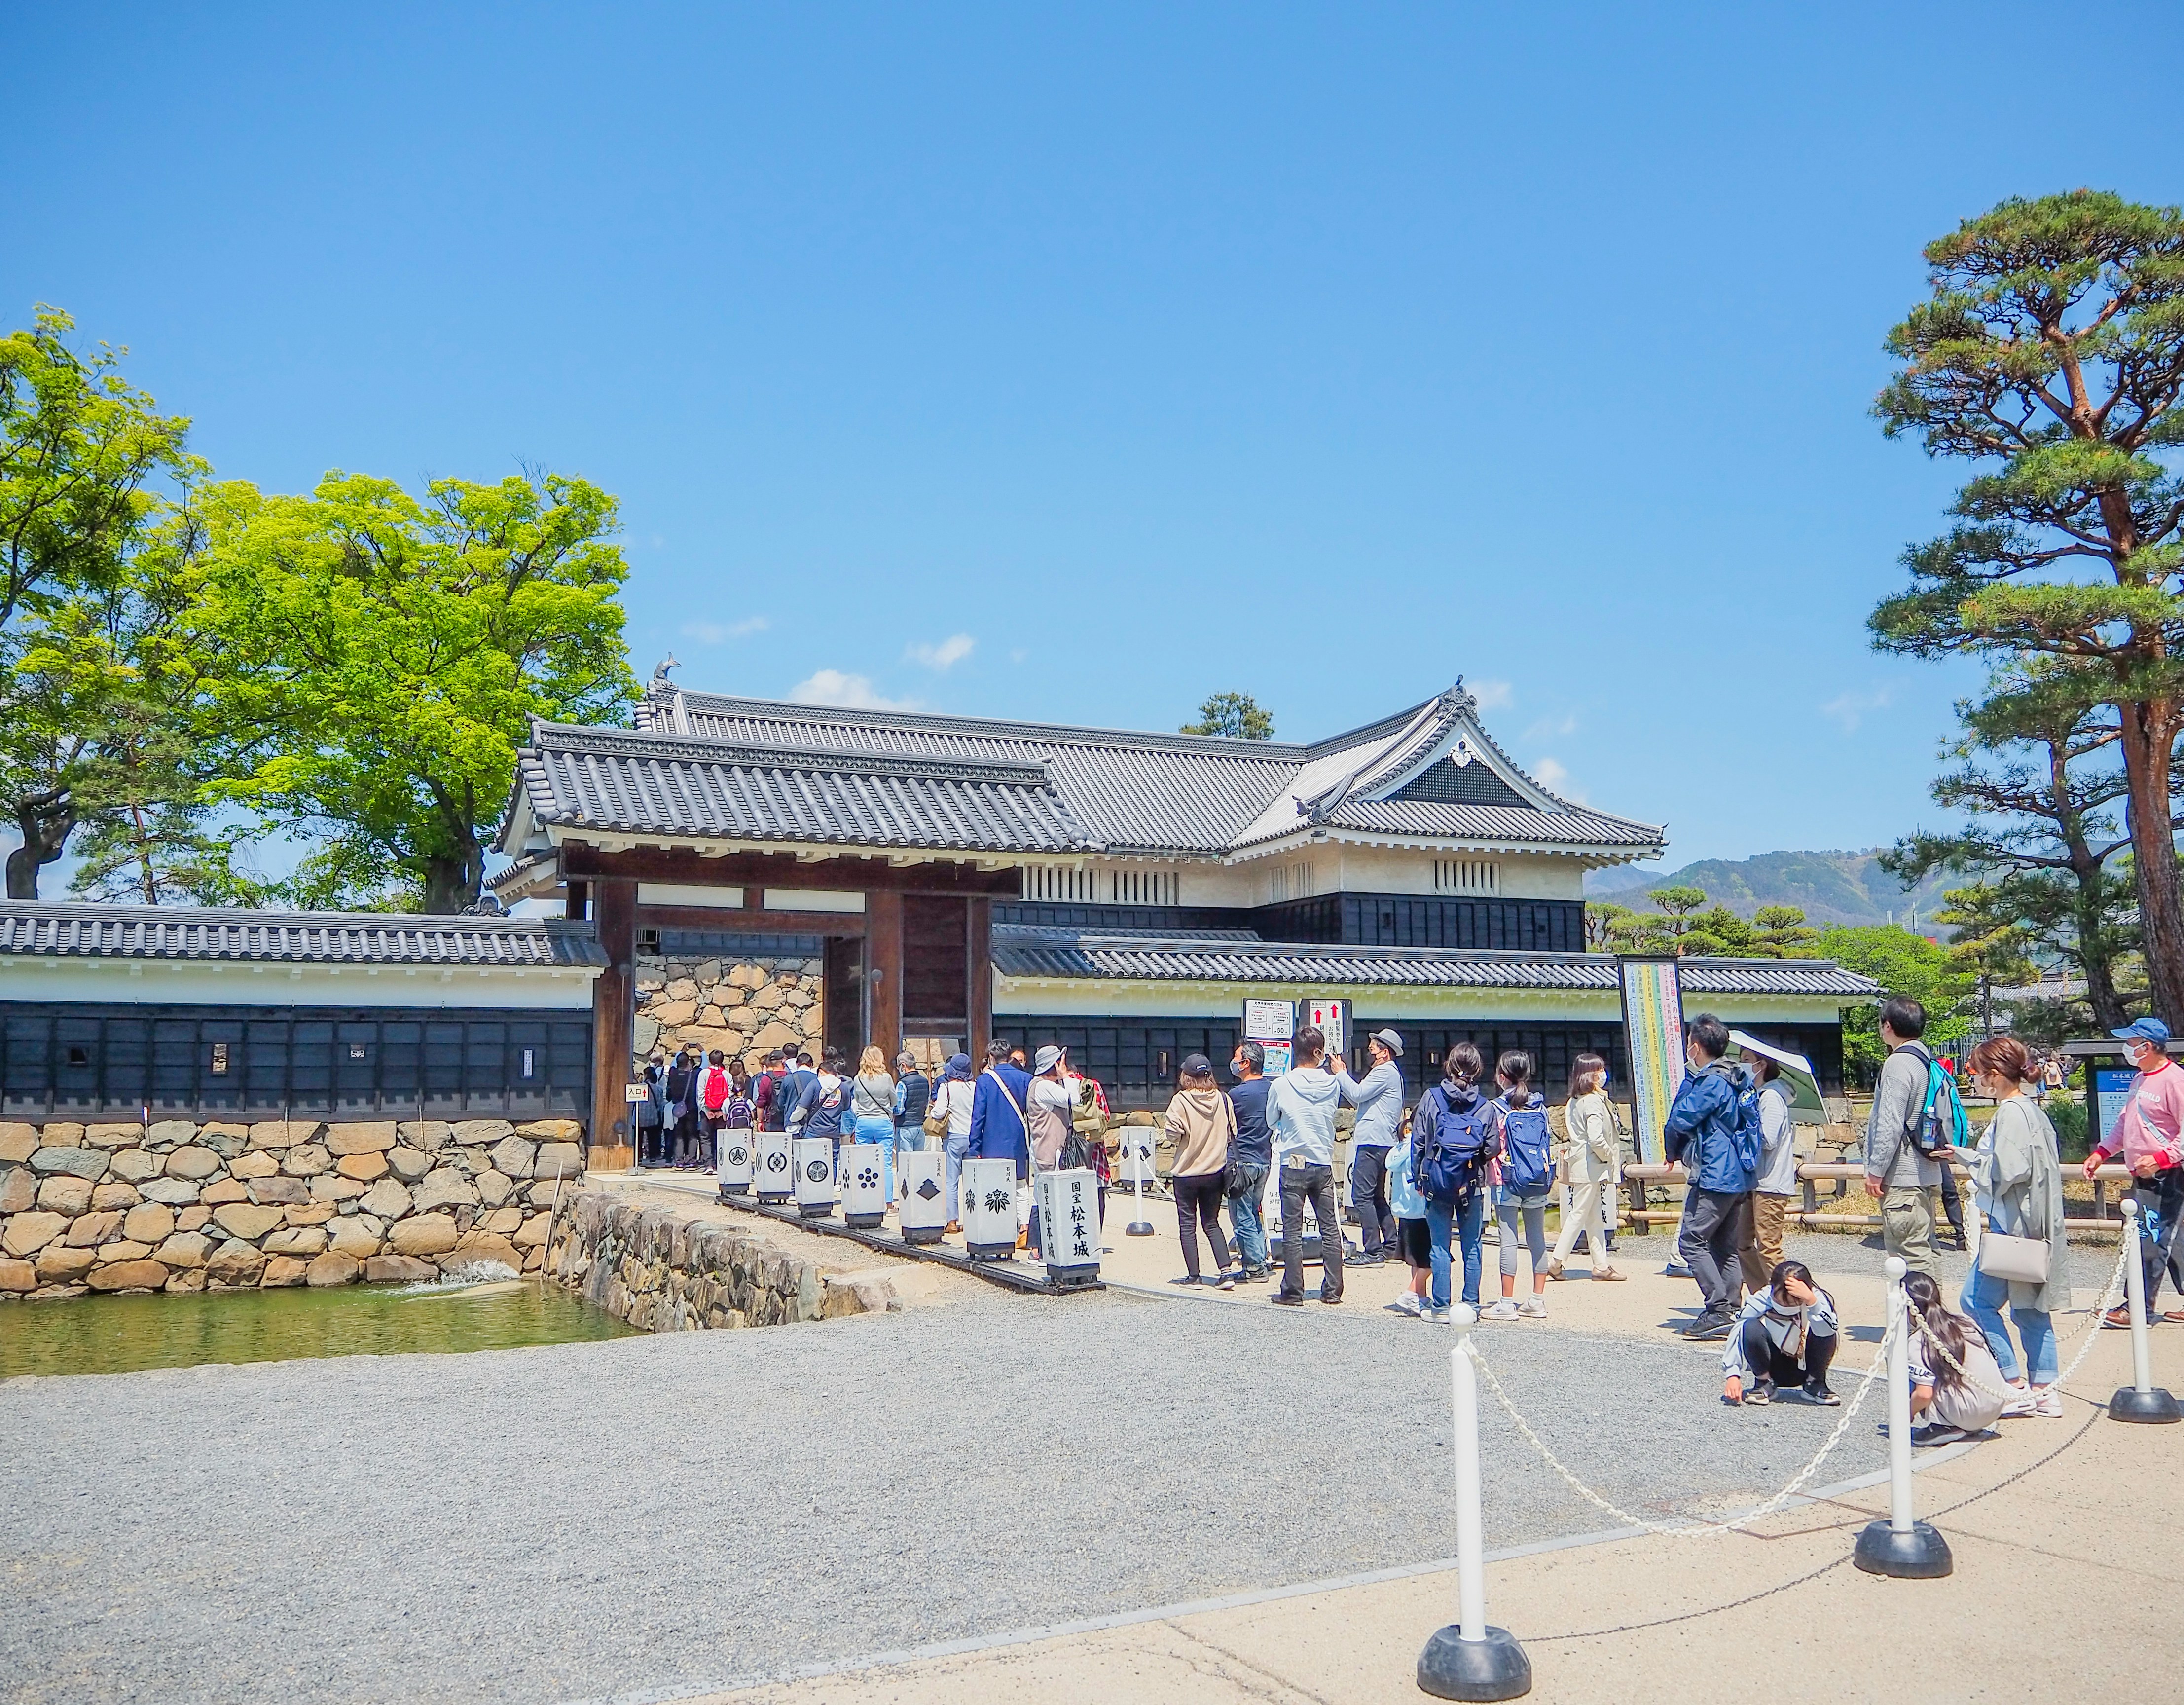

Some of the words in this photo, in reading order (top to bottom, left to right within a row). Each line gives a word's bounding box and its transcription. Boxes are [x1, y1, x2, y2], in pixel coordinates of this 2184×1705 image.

[1669, 971, 1680, 1040] お客様へのお願い
[1044, 1183, 1055, 1259] 国宝松本城
[1070, 1181, 1090, 1257] 国宝松本城
